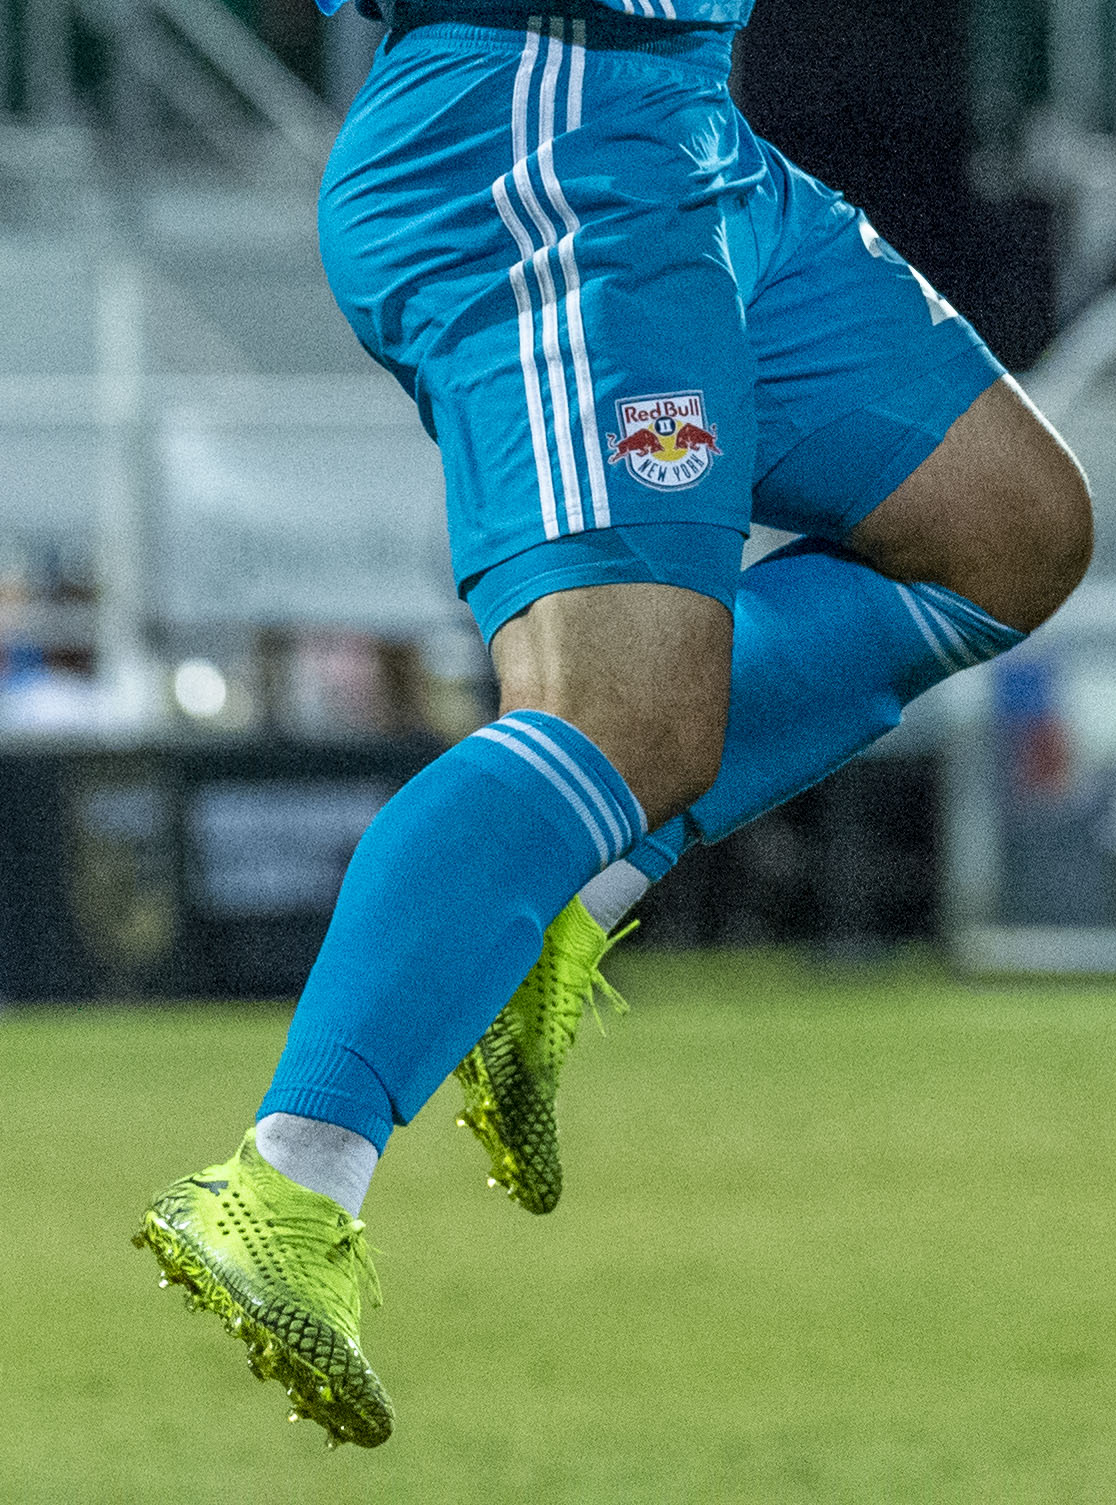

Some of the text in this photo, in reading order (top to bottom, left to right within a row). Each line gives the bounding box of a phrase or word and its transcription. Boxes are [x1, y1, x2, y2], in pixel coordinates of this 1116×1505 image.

[624, 398, 700, 424] Red Bull
[638, 454, 705, 482] NEW YORK
